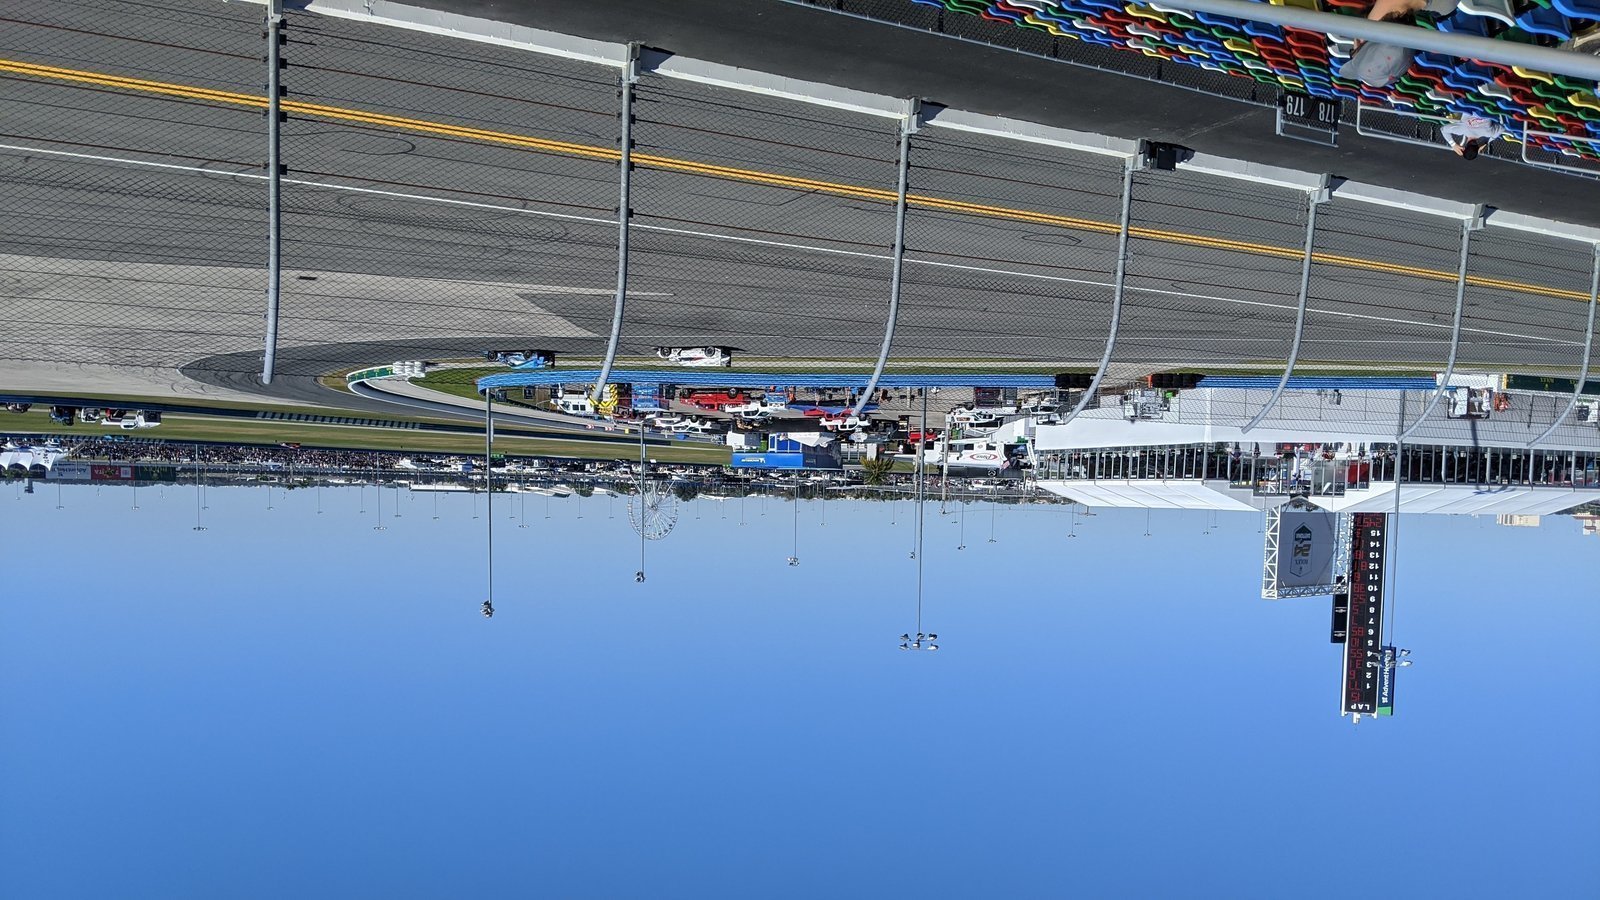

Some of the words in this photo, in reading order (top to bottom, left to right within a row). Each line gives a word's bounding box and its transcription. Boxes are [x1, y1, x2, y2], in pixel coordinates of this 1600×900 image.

[1286, 95, 1304, 117] 179
[1319, 102, 1334, 124] 178
[1294, 544, 1311, 557] 24
